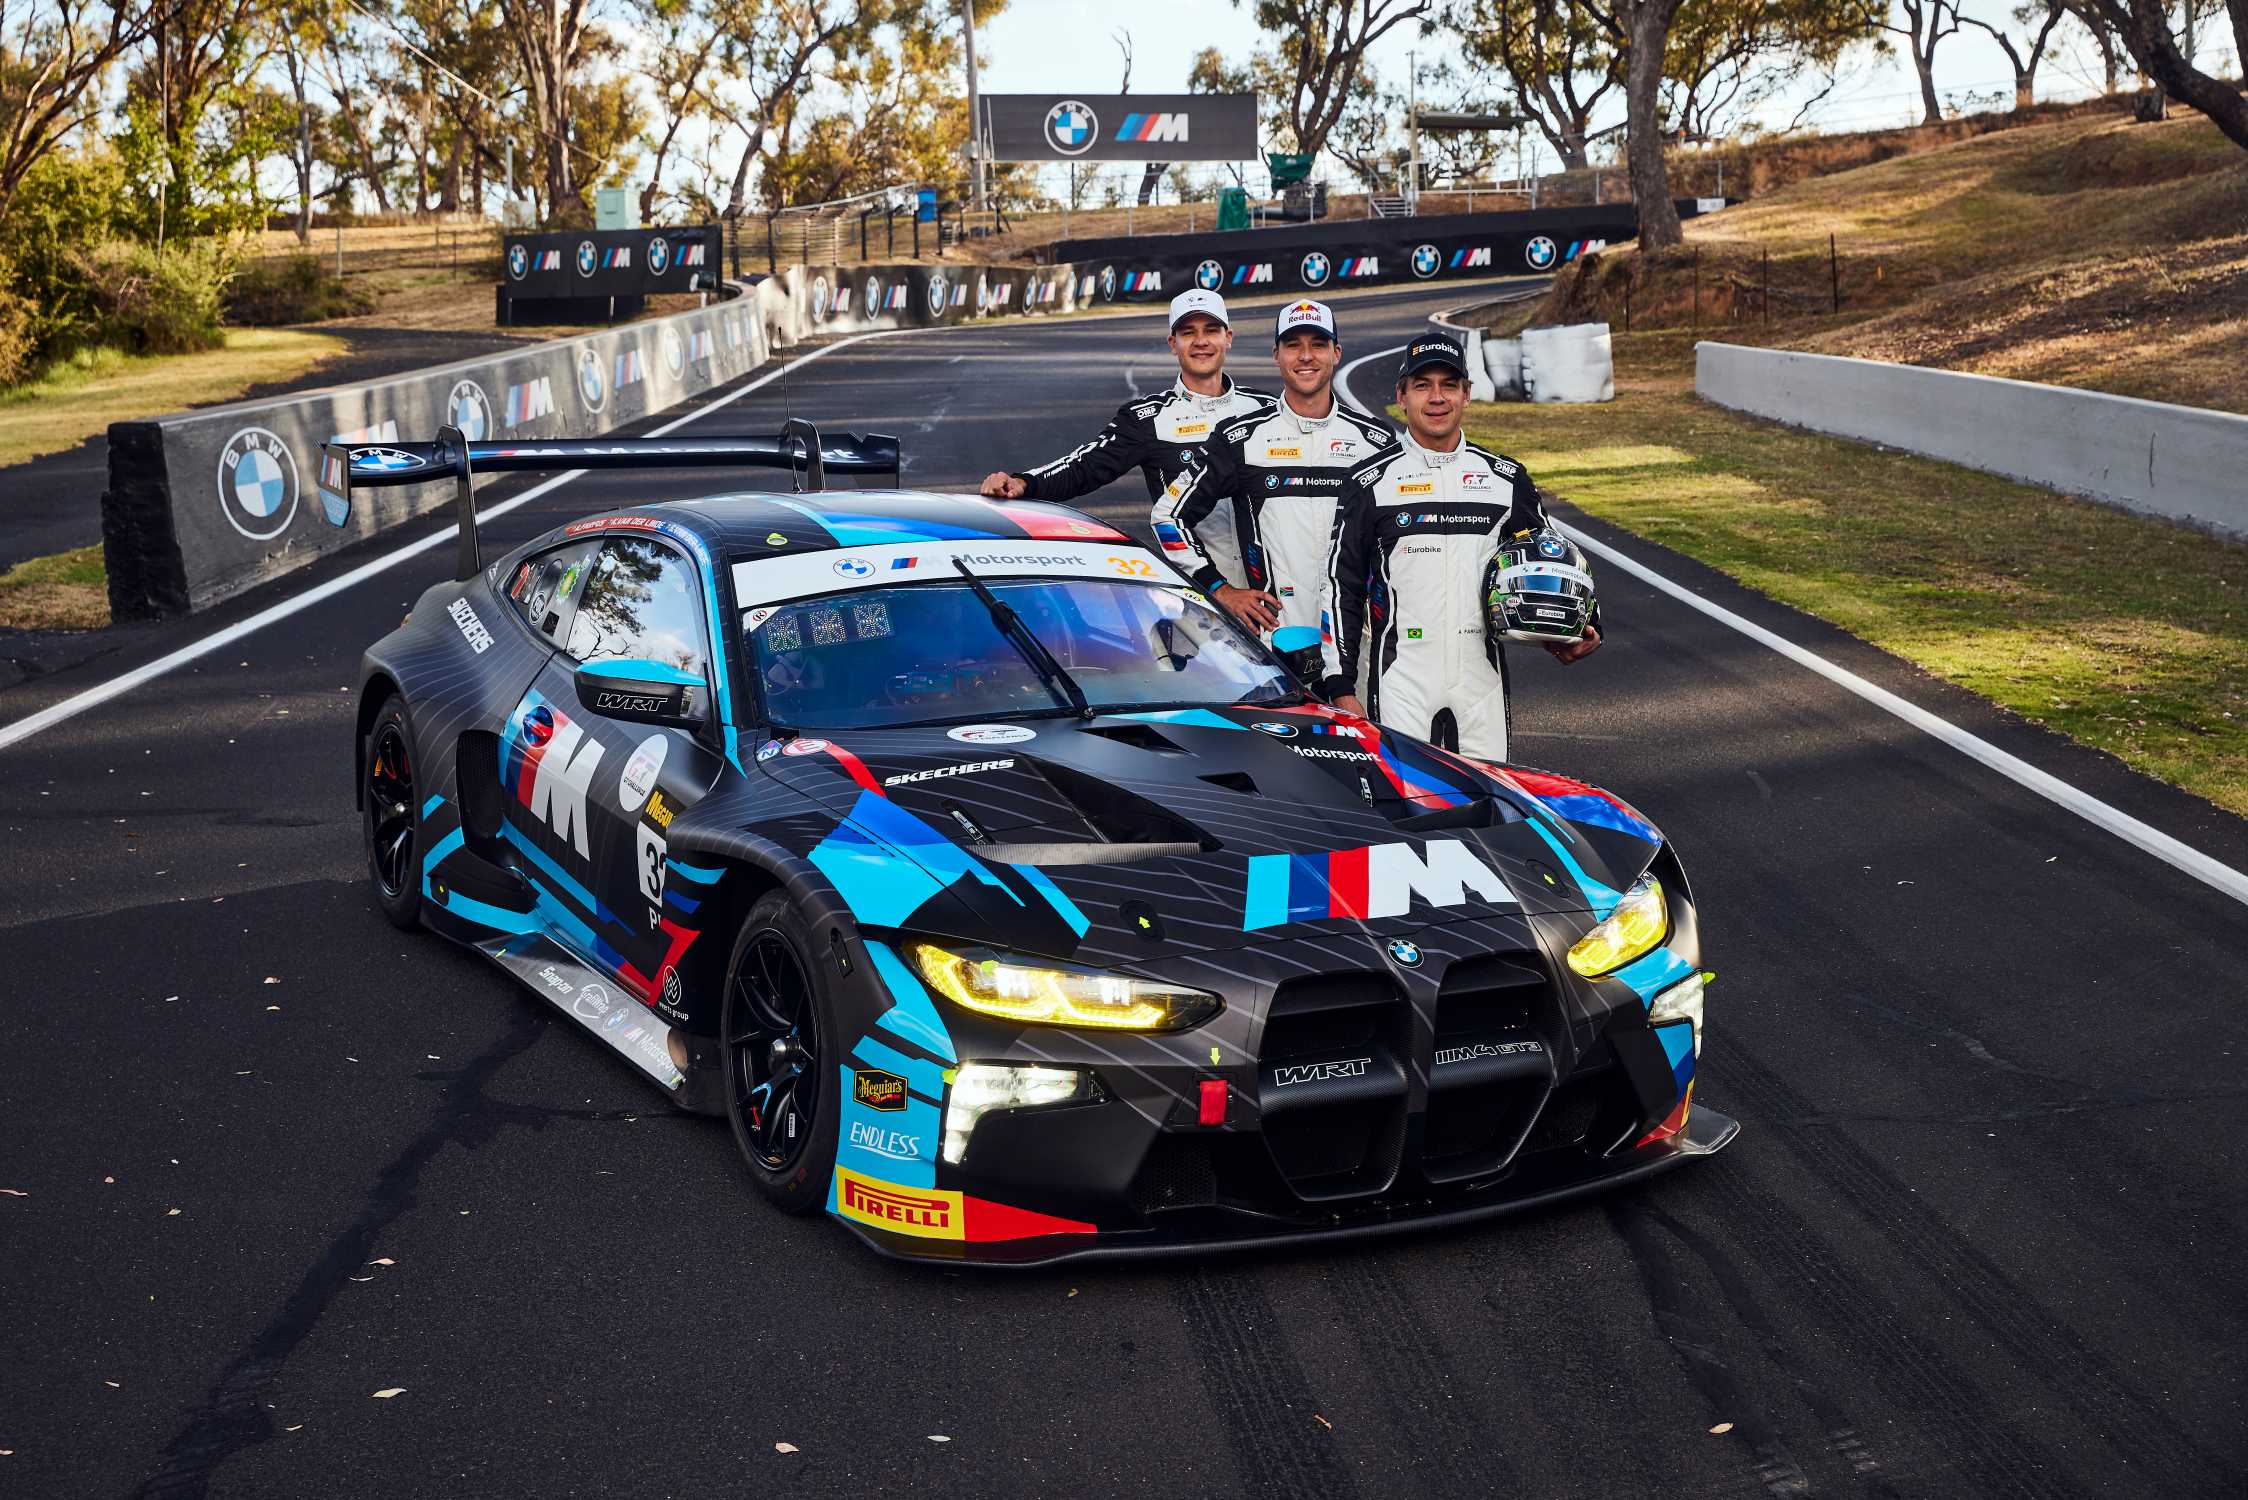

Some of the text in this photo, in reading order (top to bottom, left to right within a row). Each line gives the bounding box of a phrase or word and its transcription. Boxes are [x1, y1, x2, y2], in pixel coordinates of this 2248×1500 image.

[1052, 103, 1091, 120] BMW
[1288, 312, 1321, 324] Red Bull
[1418, 343, 1459, 357] Eurobike
[1137, 408, 1156, 418] OMP
[1228, 428, 1248, 441] OMP
[1367, 431, 1388, 444] OMP
[226, 433, 286, 470] BMW
[351, 448, 407, 461] BMW
[1494, 462, 1516, 475] OMP
[1360, 470, 1380, 485] OMP
[1440, 515, 1491, 524] Motorsport
[1407, 546, 1442, 554] Eurobike
[1106, 557, 1160, 578] 32
[447, 597, 495, 655] SKECHERS
[597, 692, 668, 712] WRT
[1287, 745, 1382, 762] Motorsport
[884, 759, 1015, 787] SKECHERS
[1275, 1057, 1372, 1087] WRT
[859, 1076, 902, 1102] Meguiar's
[850, 1121, 920, 1156] ENDLESS
[844, 1178, 951, 1228] PIRELLI
